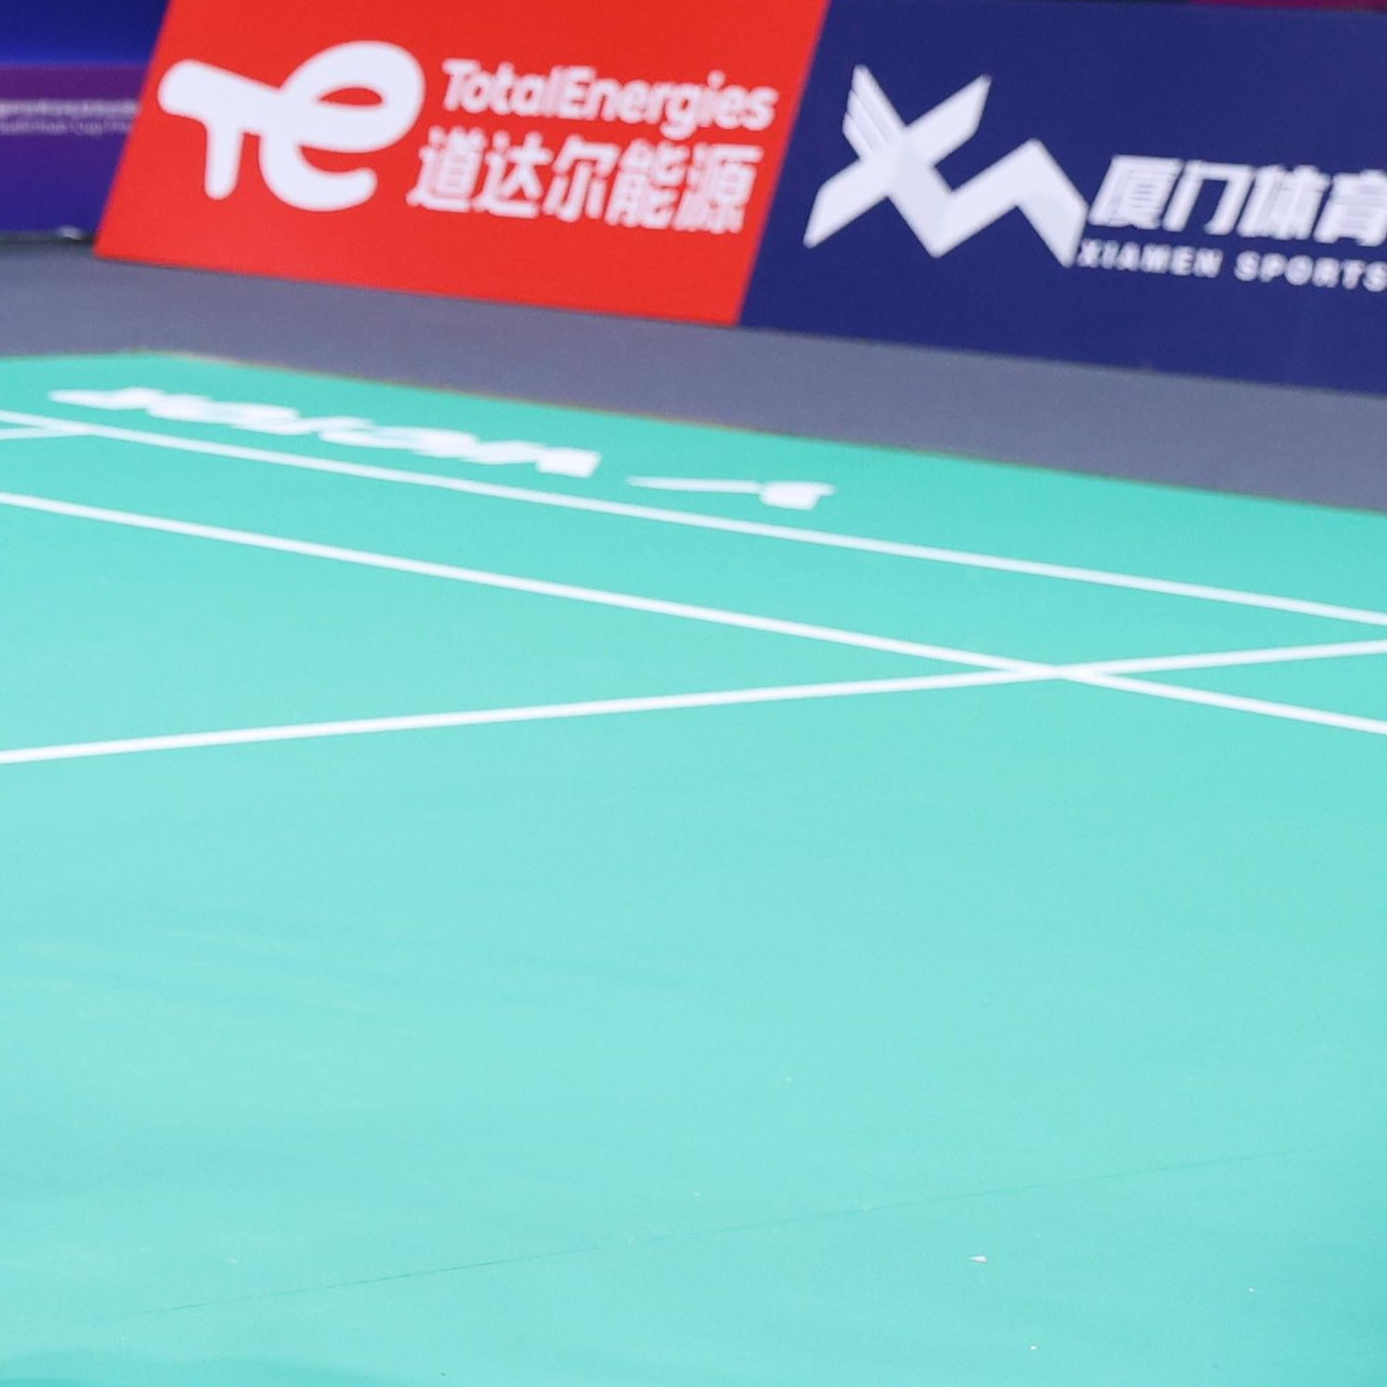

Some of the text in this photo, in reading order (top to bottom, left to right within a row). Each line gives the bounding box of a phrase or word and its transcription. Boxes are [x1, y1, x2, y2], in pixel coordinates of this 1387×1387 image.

[442, 57, 778, 140] TotalEnergies
[406, 126, 763, 234] 道达尔能源
[1077, 240, 1387, 293] XIAMEN SPORTS
